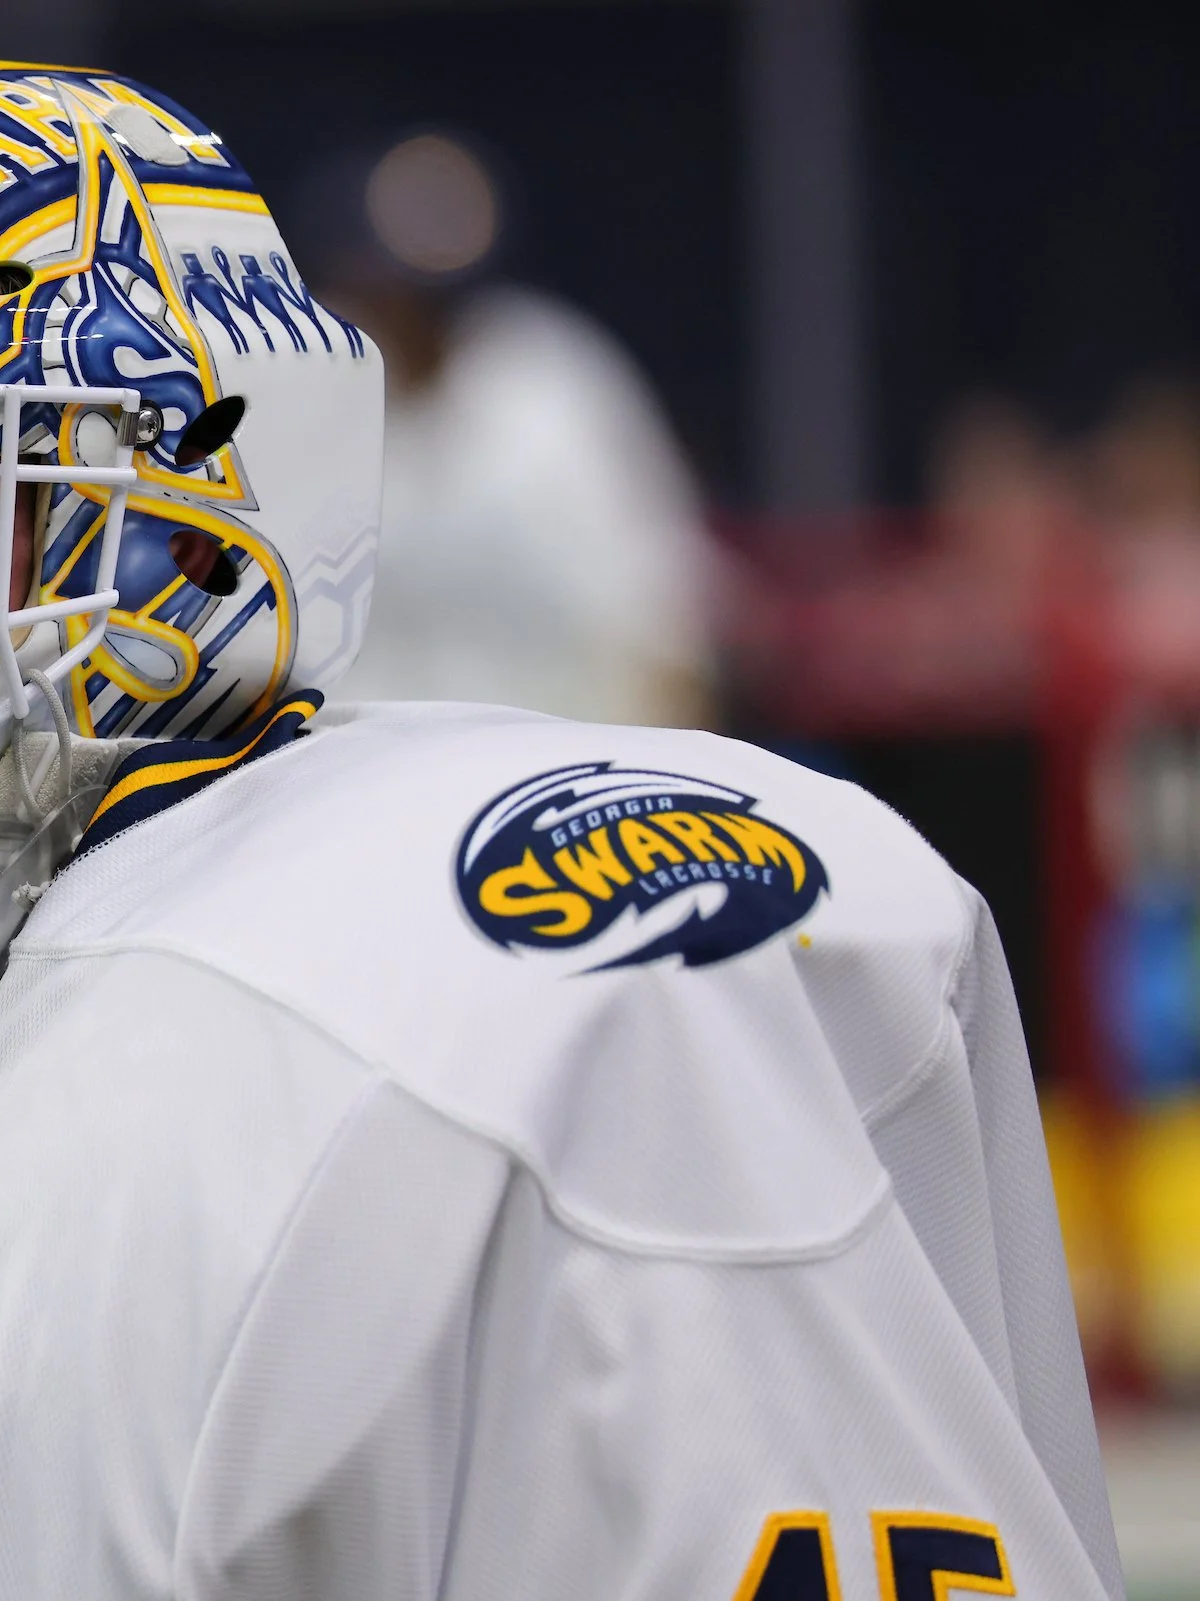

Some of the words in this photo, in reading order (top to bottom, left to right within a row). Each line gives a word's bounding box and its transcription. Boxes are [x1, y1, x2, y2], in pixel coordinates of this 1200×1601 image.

[552, 795, 675, 847] GEORGIA
[479, 810, 806, 937] SWARM
[638, 861, 774, 896] LACROSSE
